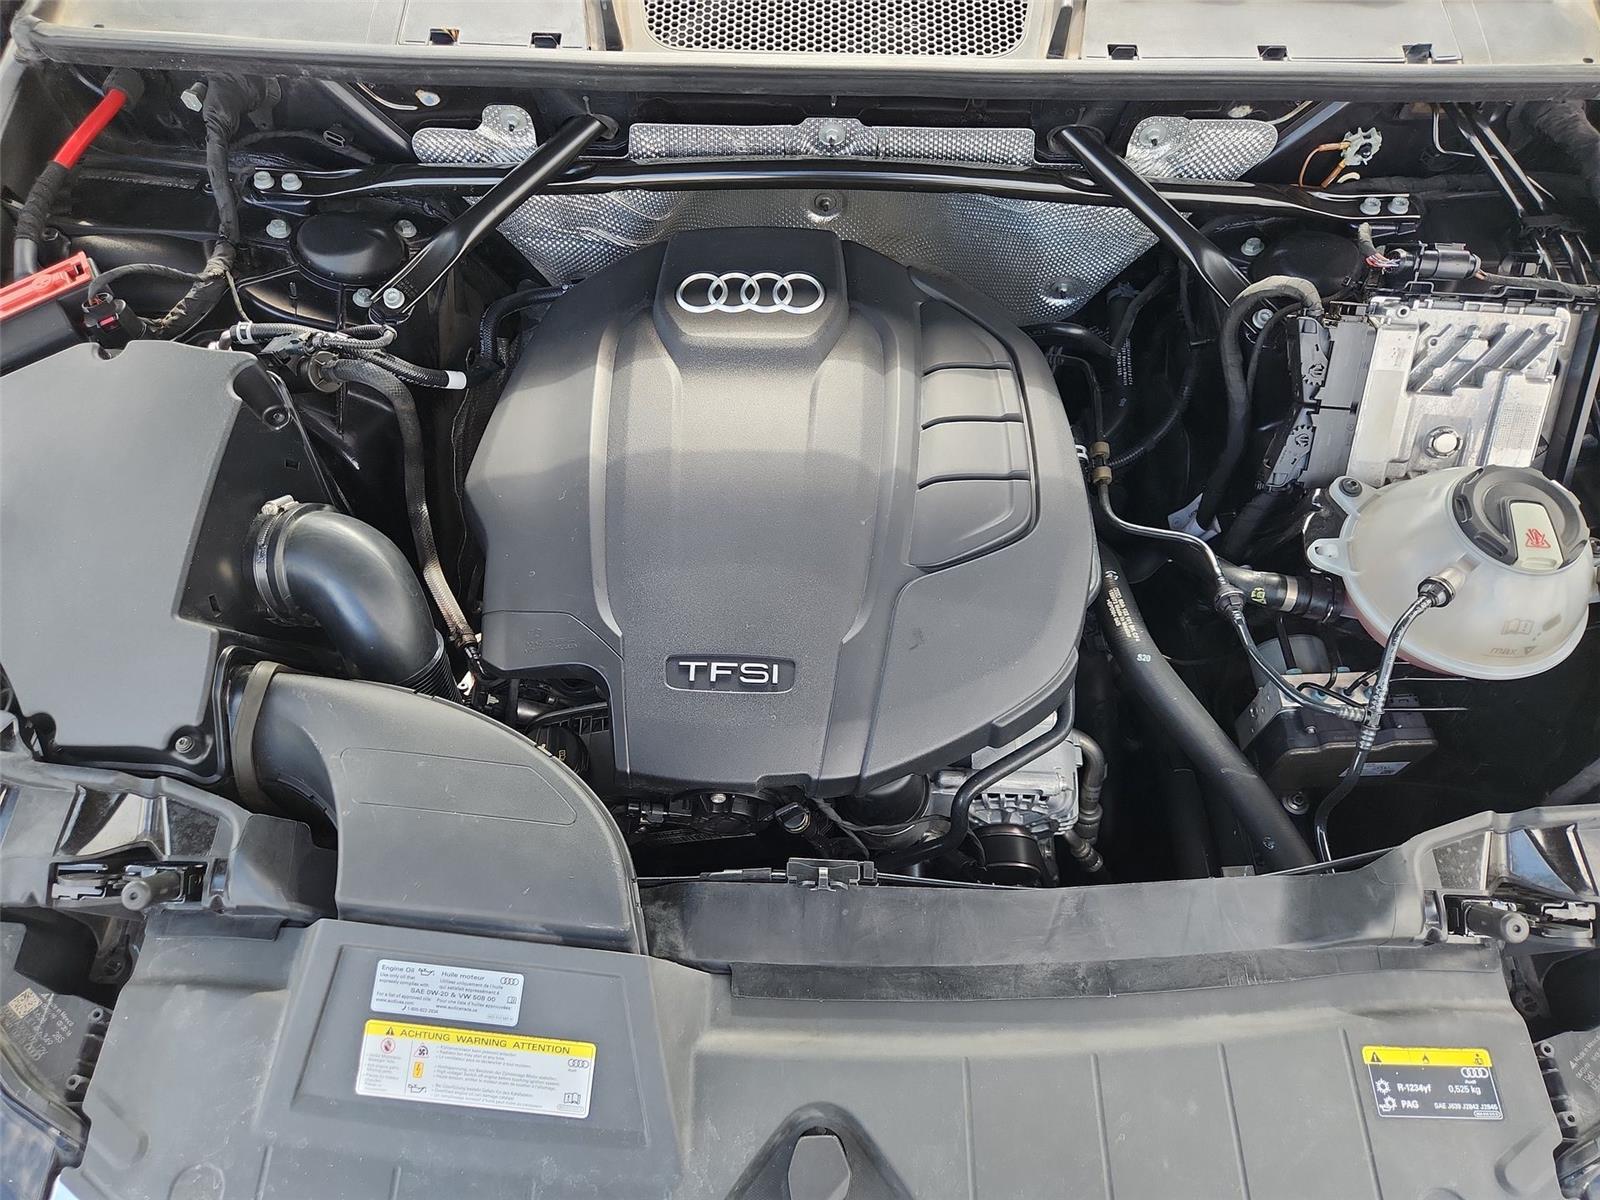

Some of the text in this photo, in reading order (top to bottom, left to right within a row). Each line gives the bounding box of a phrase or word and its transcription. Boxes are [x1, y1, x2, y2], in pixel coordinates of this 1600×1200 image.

[679, 661, 778, 684] TFSI
[381, 963, 404, 972] Engine
[440, 970, 485, 981] Huile moteur
[426, 988, 448, 997] 0W-20
[457, 992, 471, 1000] VW
[399, 1028, 450, 1041] ACHTUNG
[455, 1034, 507, 1048] WARNING
[512, 1040, 570, 1055] ATTENTION
[1396, 1083, 1431, 1094] R-1234yf
[1471, 1084, 1482, 1095] kg
[1400, 1099, 1419, 1109] PAG
[1433, 1102, 1447, 1110] SAE
